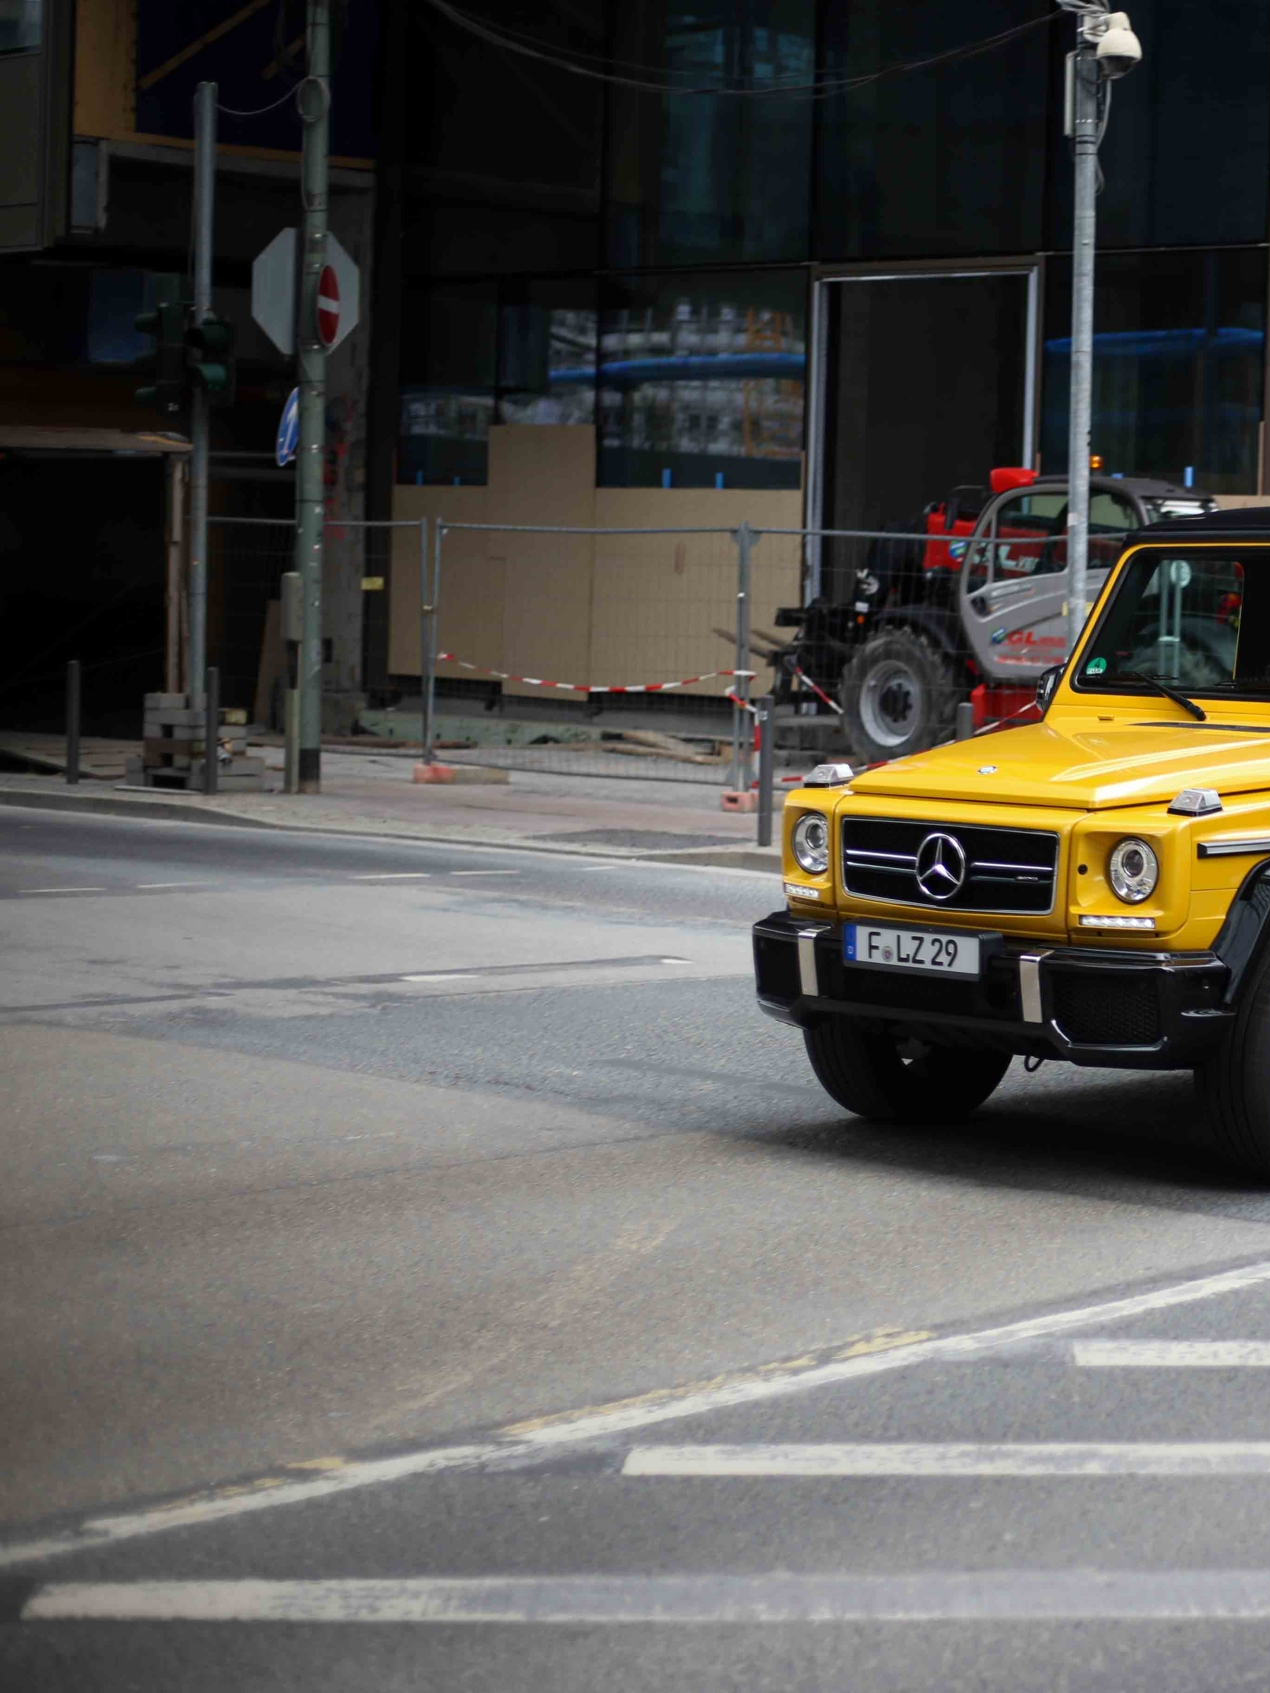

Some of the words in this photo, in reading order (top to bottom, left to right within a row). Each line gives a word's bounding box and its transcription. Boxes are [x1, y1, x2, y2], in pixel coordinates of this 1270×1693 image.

[868, 931, 881, 959] F
[896, 934, 926, 965] LZ
[930, 937, 959, 968] 29
